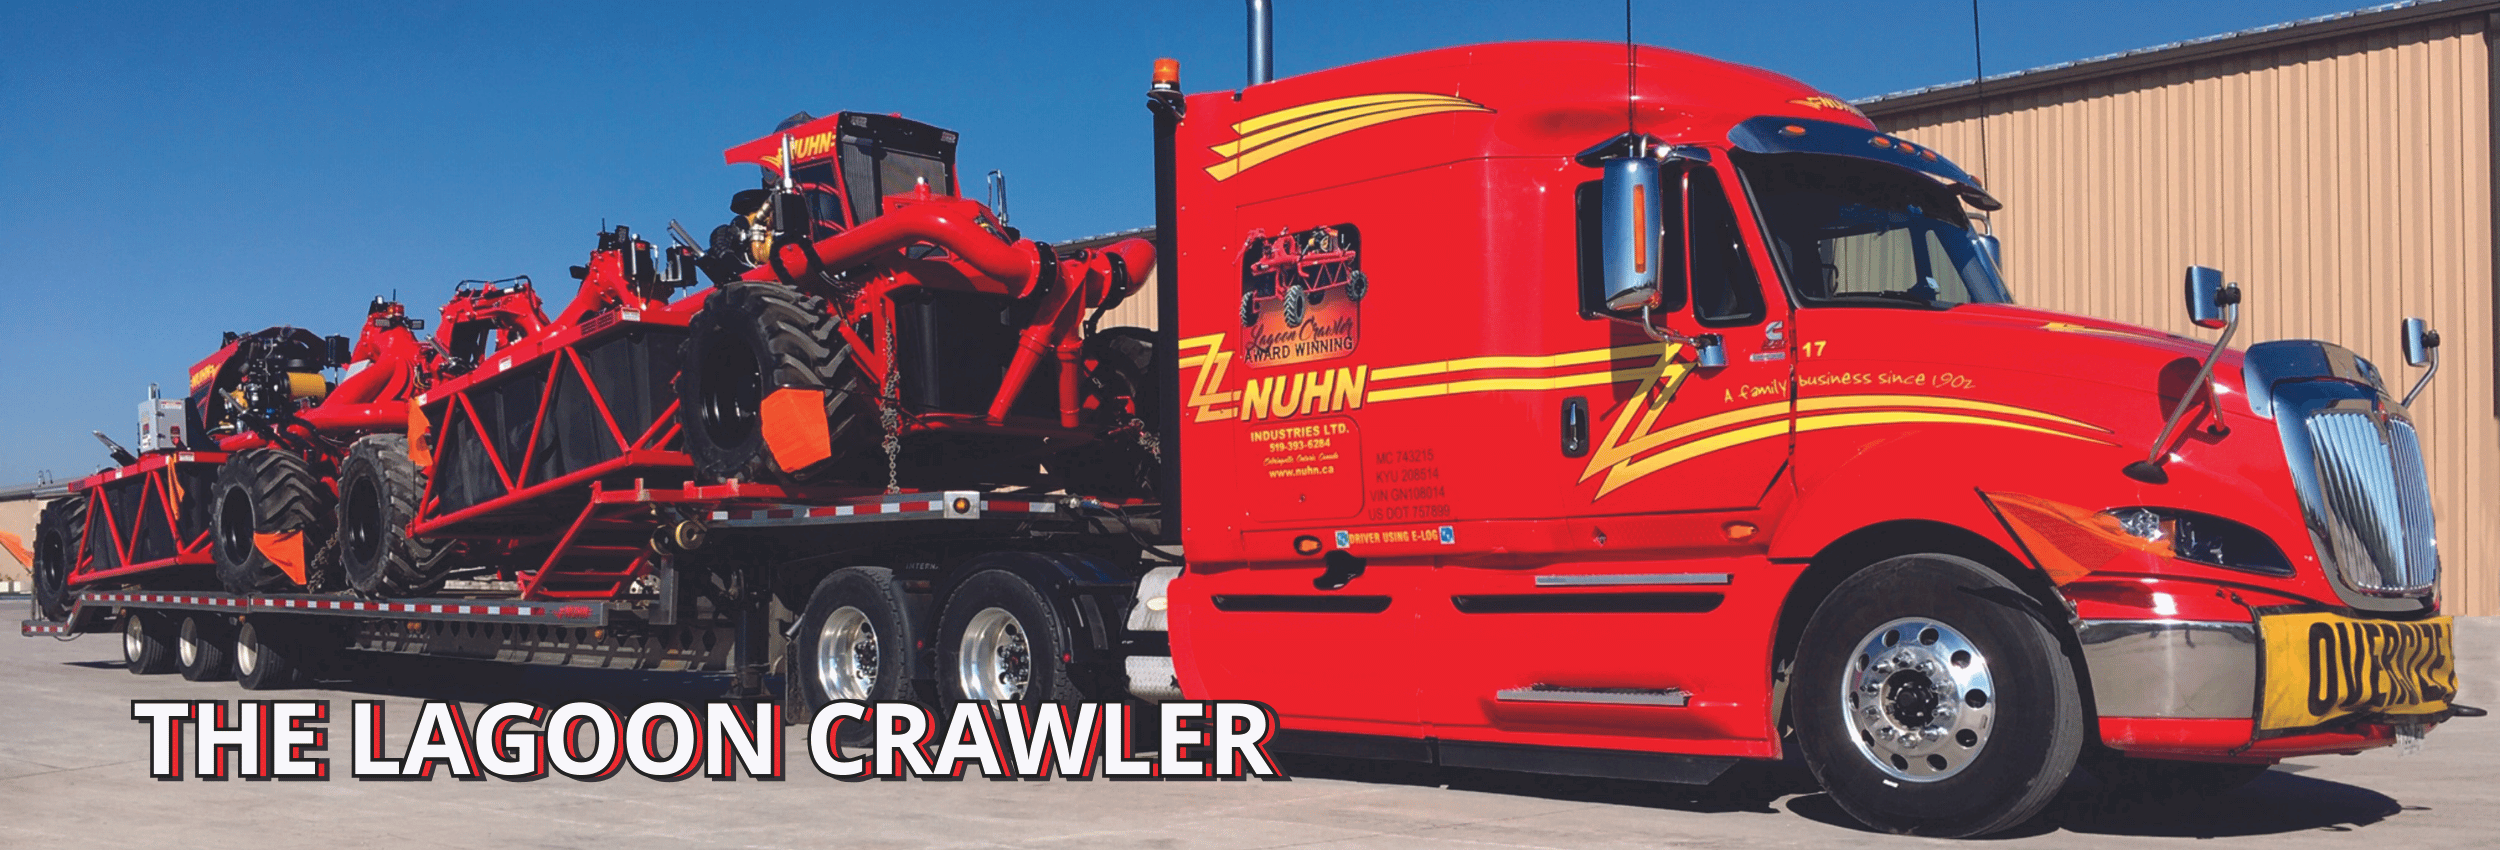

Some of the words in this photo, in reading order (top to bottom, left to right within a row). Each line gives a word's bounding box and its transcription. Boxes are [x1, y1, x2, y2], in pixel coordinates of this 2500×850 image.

[1244, 345, 1291, 363] AWARD
[1294, 336, 1353, 357] WINNING
[1802, 340, 1827, 358] 17
[1240, 364, 1369, 422] NUHN
[1724, 388, 1735, 403] A
[1738, 379, 1788, 400] family
[1798, 371, 1872, 387] business
[1878, 370, 1926, 386] since
[1250, 425, 1321, 443] INDUSTRIES
[1323, 422, 1350, 436] LTD.
[1269, 437, 1331, 453] 519-393-6284
[1376, 451, 1393, 465] MC
[1396, 447, 1434, 463] 743215
[1268, 464, 1335, 479] www.nuhn.ca
[1376, 470, 1399, 483] KYU
[1401, 466, 1439, 482] 208514
[1369, 489, 1388, 502] VIN
[1368, 508, 1384, 521] US
[1386, 506, 1409, 520] DOT
[1349, 532, 1381, 545] DRIVER
[1382, 530, 1410, 543] USING
[1411, 529, 1438, 542] E-LOG
